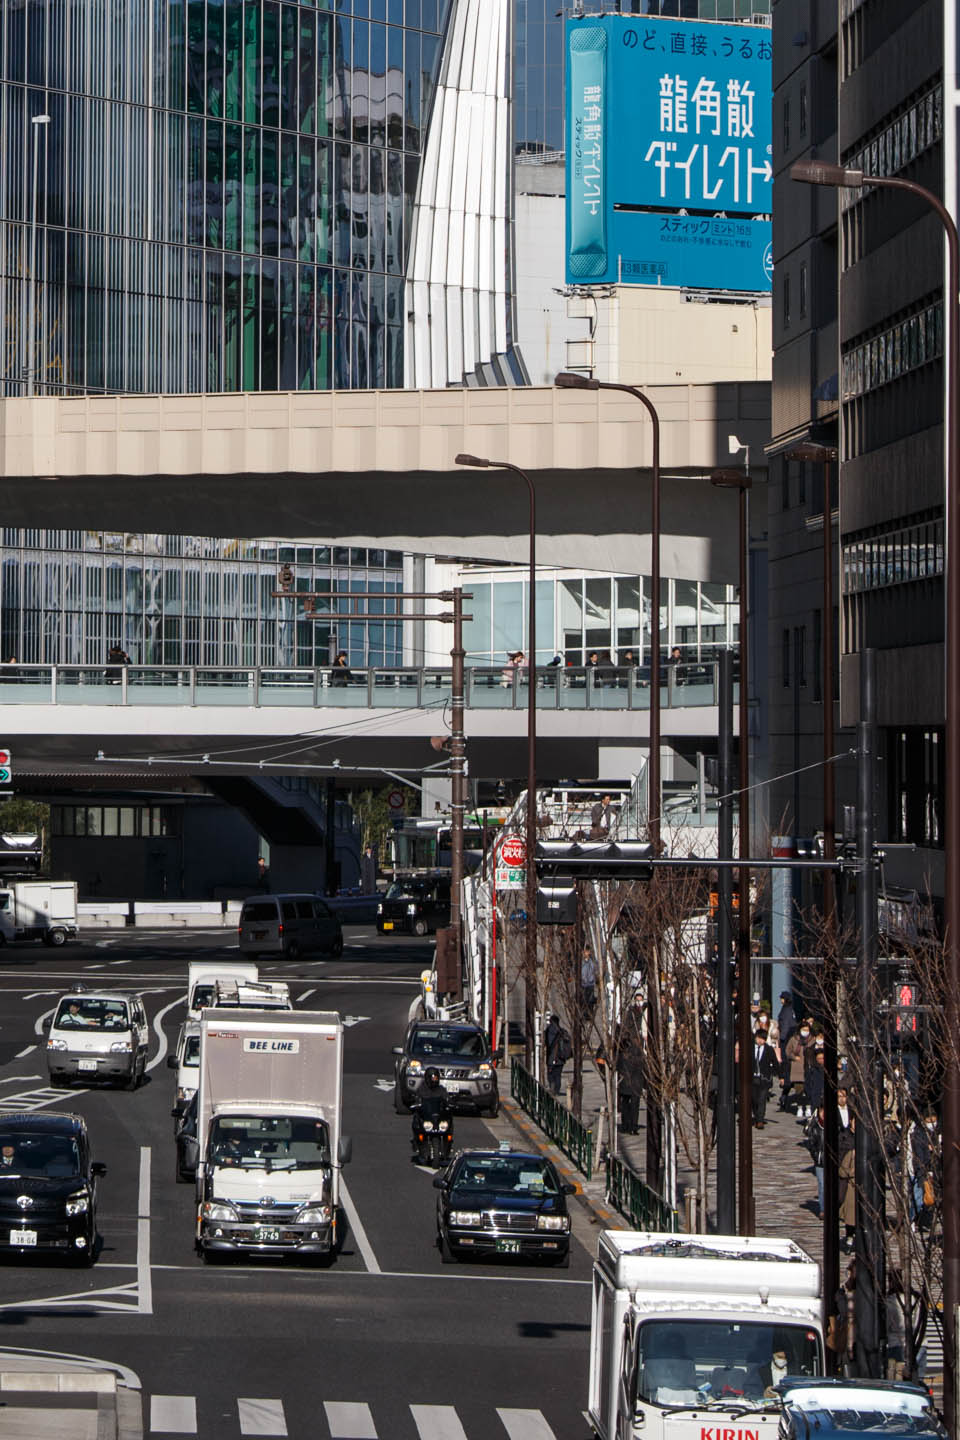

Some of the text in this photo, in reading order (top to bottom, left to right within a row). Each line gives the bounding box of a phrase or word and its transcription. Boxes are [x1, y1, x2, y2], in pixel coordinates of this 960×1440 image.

[659, 73, 756, 139] 龍角散
[659, 217, 709, 235] スティック
[249, 1041, 294, 1051] BEE LINE
[700, 1427, 759, 1440] KIRIN
